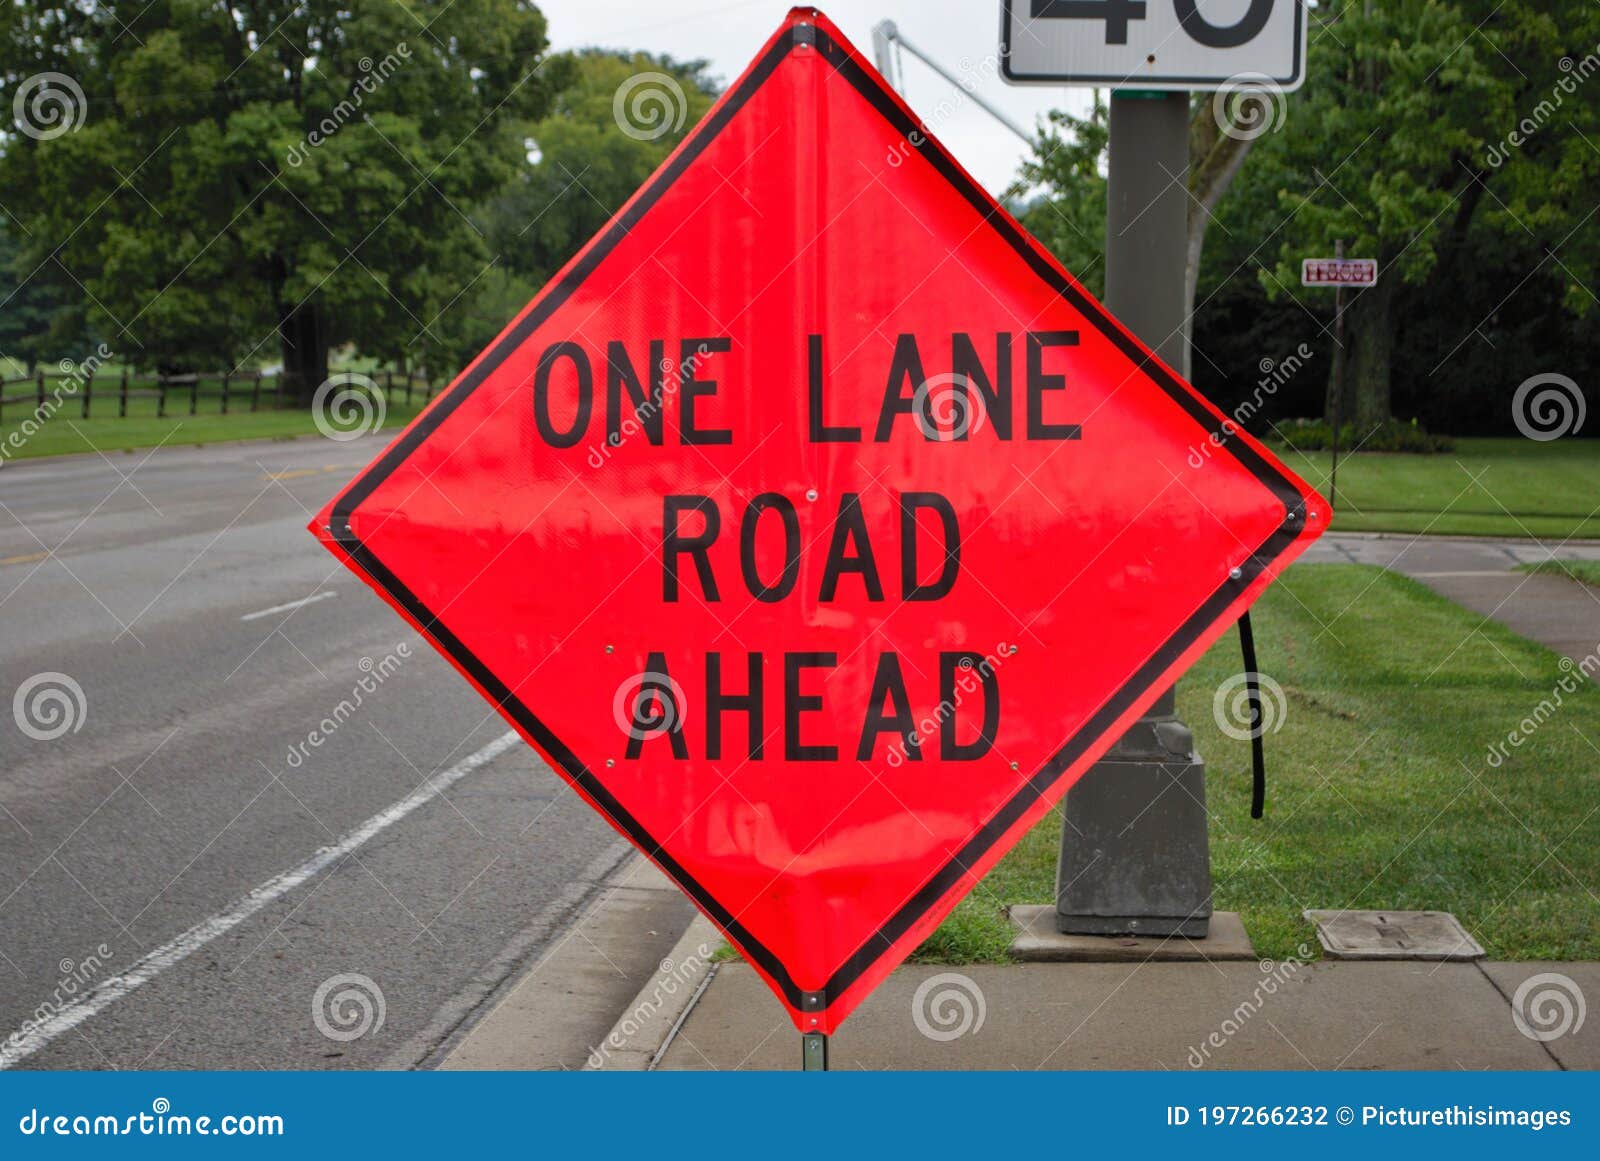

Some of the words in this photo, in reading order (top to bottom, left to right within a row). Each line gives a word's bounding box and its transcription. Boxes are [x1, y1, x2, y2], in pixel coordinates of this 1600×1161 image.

[533, 337, 732, 448] ONE
[808, 330, 1081, 442] LANE
[662, 492, 961, 603] ROAD
[625, 651, 1000, 762] AHEAD
